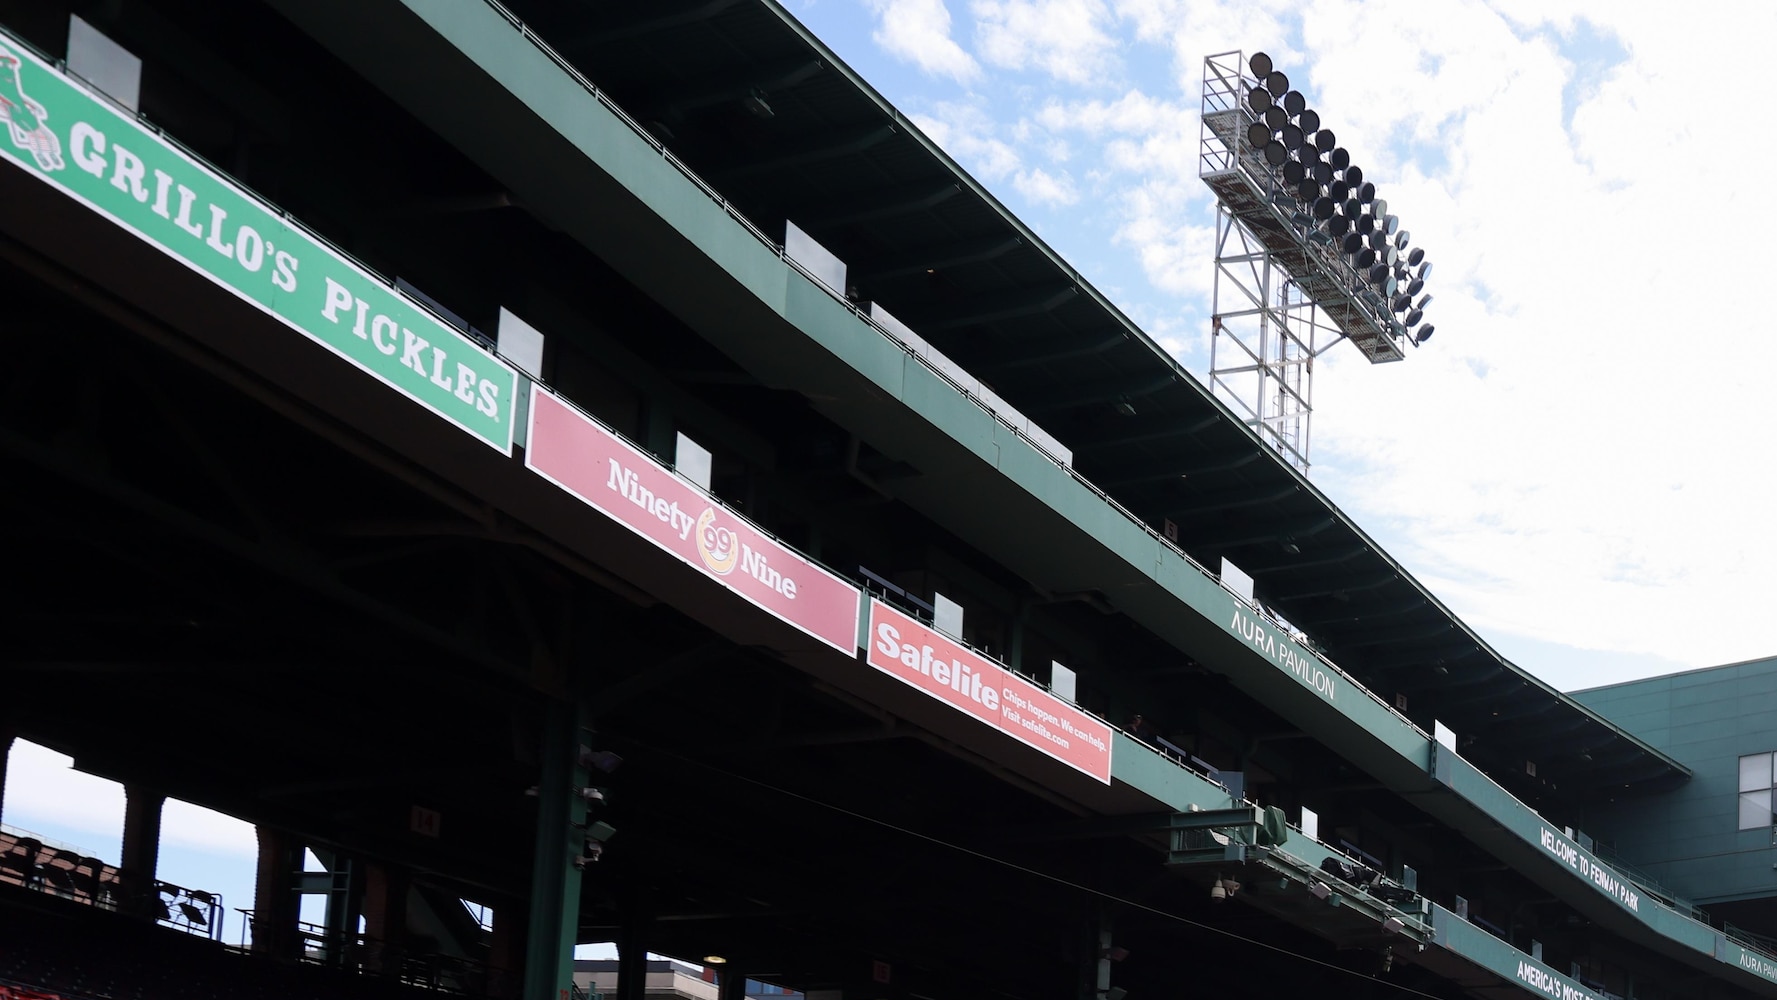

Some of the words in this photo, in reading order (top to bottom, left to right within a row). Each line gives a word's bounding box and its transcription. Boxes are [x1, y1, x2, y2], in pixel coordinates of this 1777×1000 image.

[70, 121, 300, 293] GRILLO'S
[321, 276, 499, 420] PICKLES
[606, 457, 696, 541] Ninety
[702, 525, 731, 552] 99
[740, 546, 797, 600] Nine
[876, 622, 999, 712] Safelite
[1279, 643, 1335, 700] PAVILION
[1002, 705, 1021, 725] Visit
[1022, 718, 1069, 749] safelite.com
[1003, 688, 1027, 709] Chips
[1028, 700, 1060, 727] happen.
[1061, 718, 1073, 734] We
[1074, 729, 1088, 742] can
[1088, 733, 1106, 752] help.
[1541, 826, 1577, 869] WELCOME
[1579, 854, 1588, 876] TO
[1590, 863, 1619, 898] FENWAY
[1620, 884, 1638, 913] PARK
[1517, 960, 1561, 998] AMERICA'S
